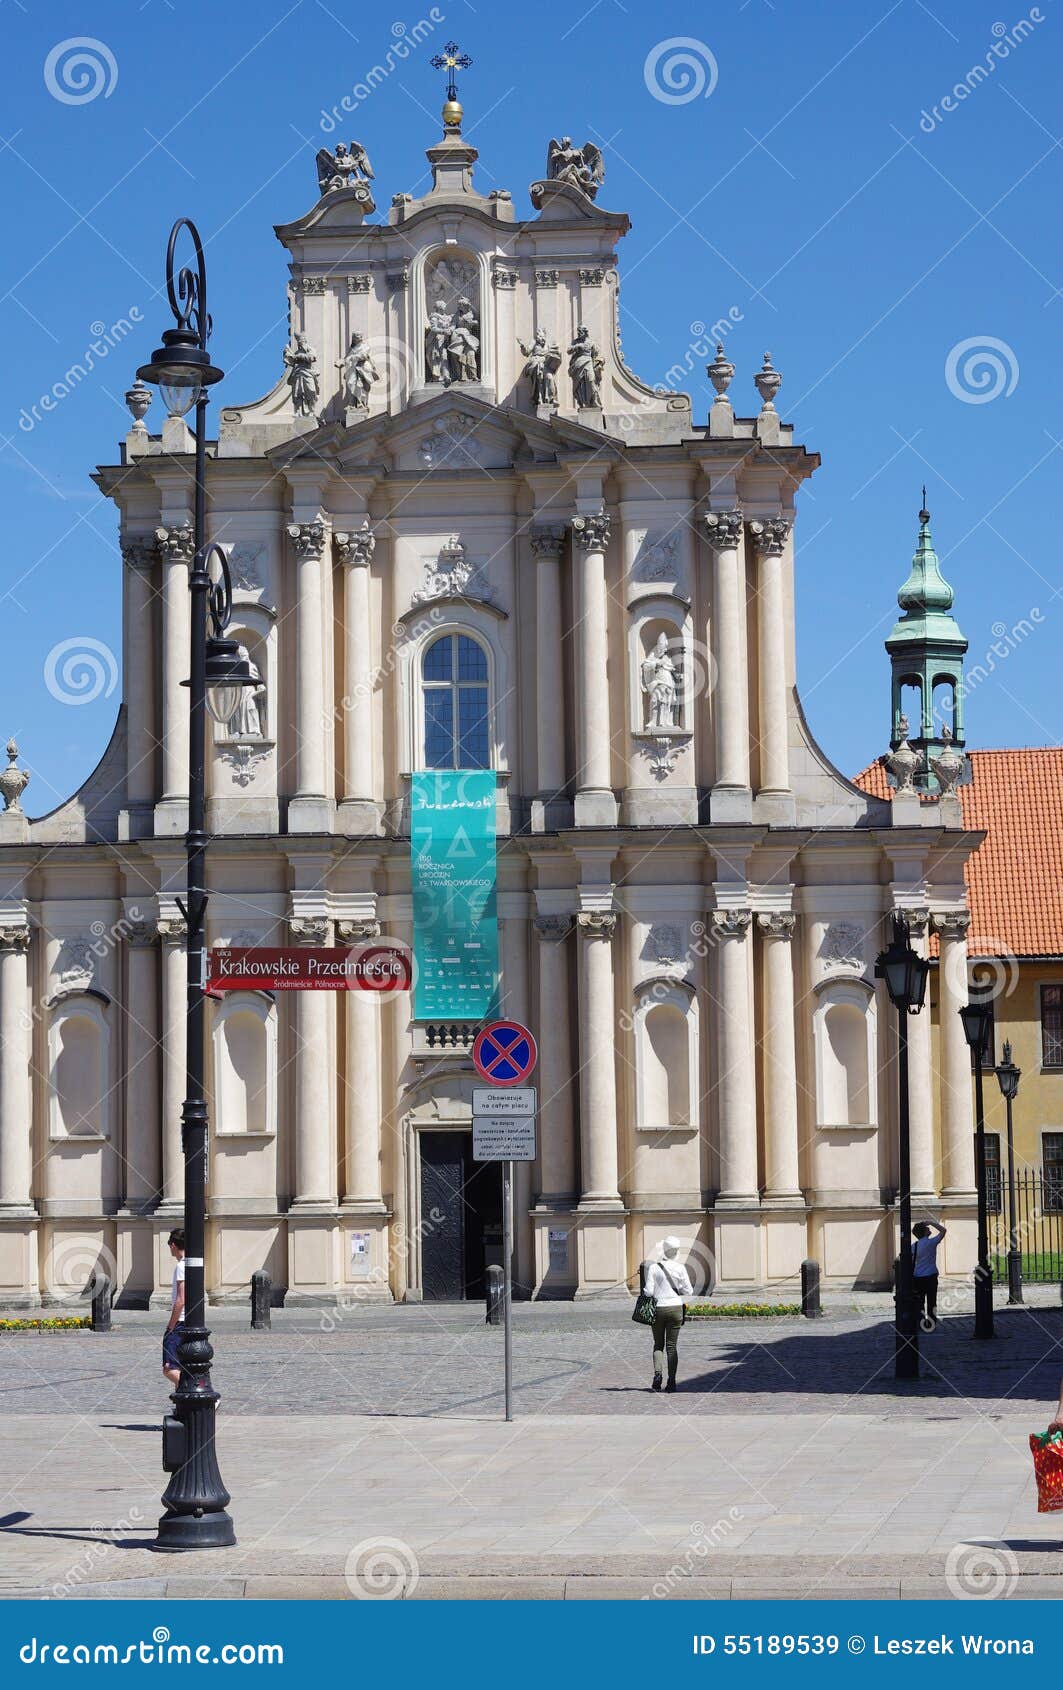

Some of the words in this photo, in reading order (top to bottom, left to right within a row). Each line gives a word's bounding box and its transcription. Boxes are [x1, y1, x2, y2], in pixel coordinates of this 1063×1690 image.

[430, 879, 491, 887] TWARDOWSKIEGO
[219, 957, 300, 975] Krakowskie
[308, 957, 401, 976] Przedmieście
[273, 978, 313, 988] Śródmieście
[314, 979, 346, 988] Północne
